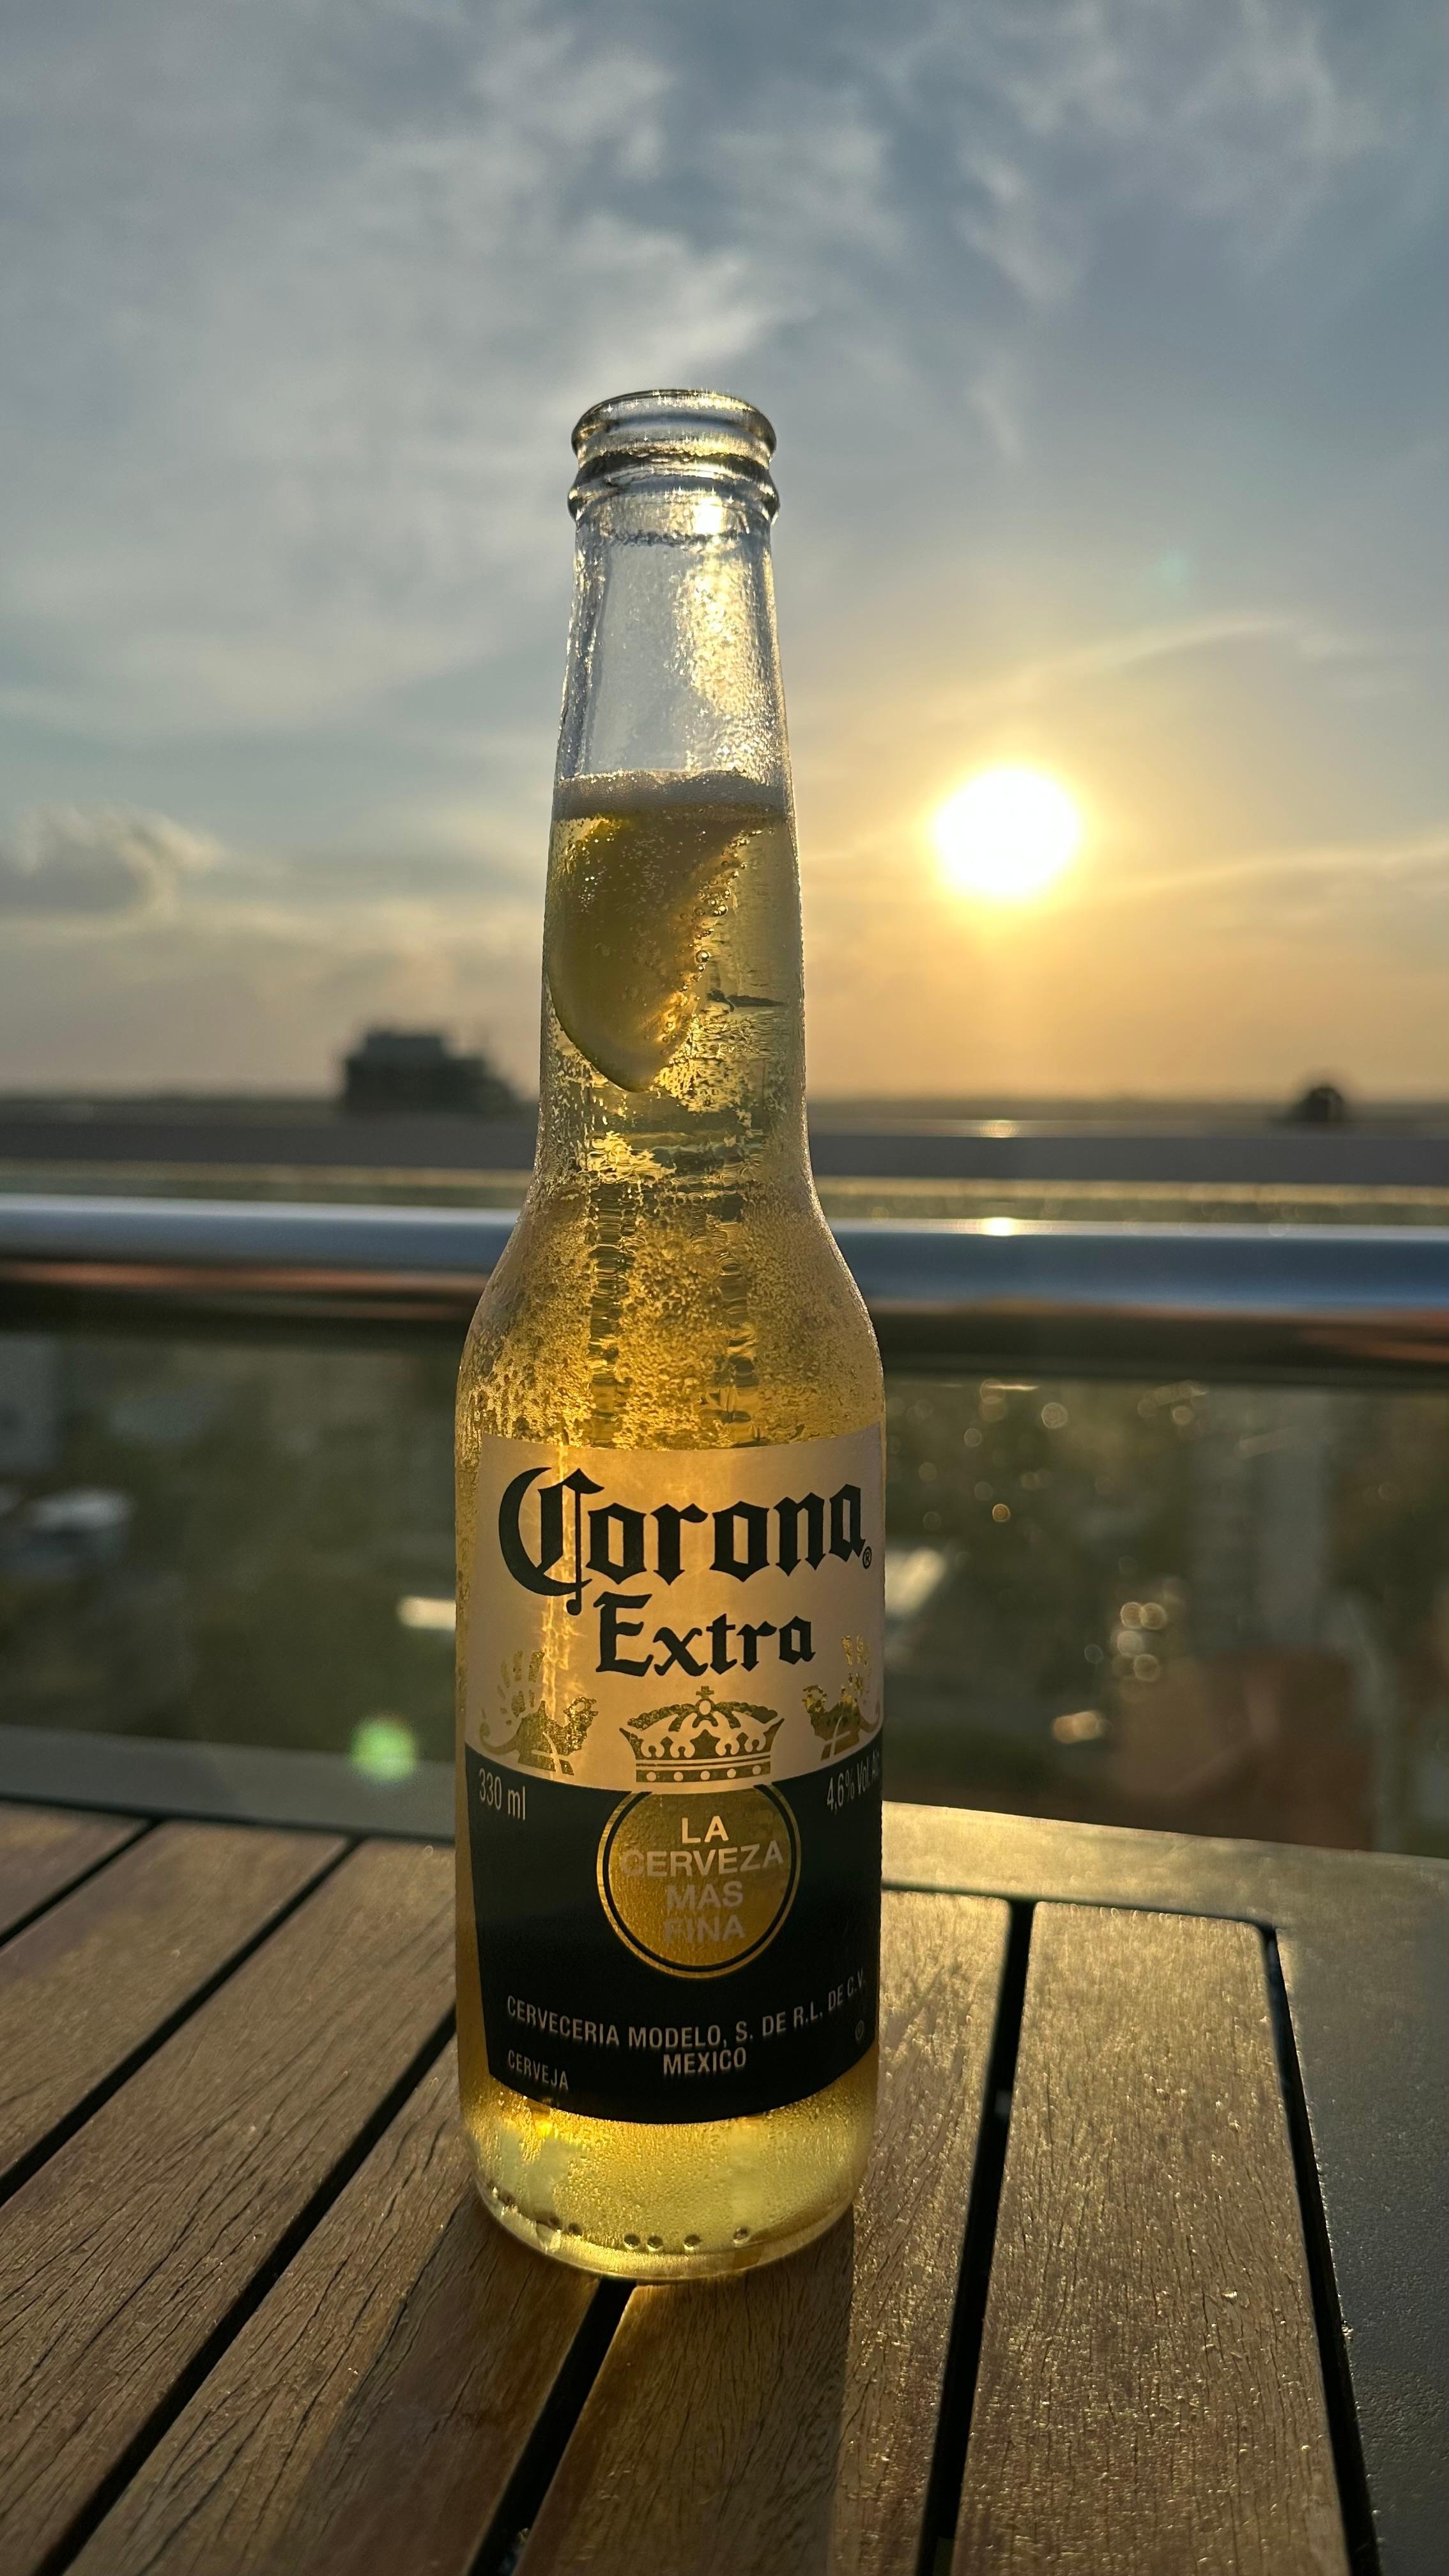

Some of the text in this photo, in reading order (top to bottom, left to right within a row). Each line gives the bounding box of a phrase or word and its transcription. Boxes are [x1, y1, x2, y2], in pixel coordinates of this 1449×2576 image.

[594, 1591, 816, 1677] Extra
[479, 1768, 526, 1821] 330 ml
[827, 1768, 855, 1815] 4,6%
[681, 1815, 729, 1844] LA
[620, 1839, 784, 1877] CERVEZA
[666, 1880, 744, 1912] MAS
[664, 1914, 746, 1943] FINA
[507, 1995, 620, 2046] CERVECERIA
[629, 2025, 727, 2048] MODELO,
[735, 2021, 753, 2043] S.
[762, 2011, 787, 2037] DE
[793, 2001, 823, 2029] R.L.
[828, 1984, 843, 2012] DE
[508, 2050, 569, 2091] CERVEJA
[663, 2046, 747, 2076] MEXICO
